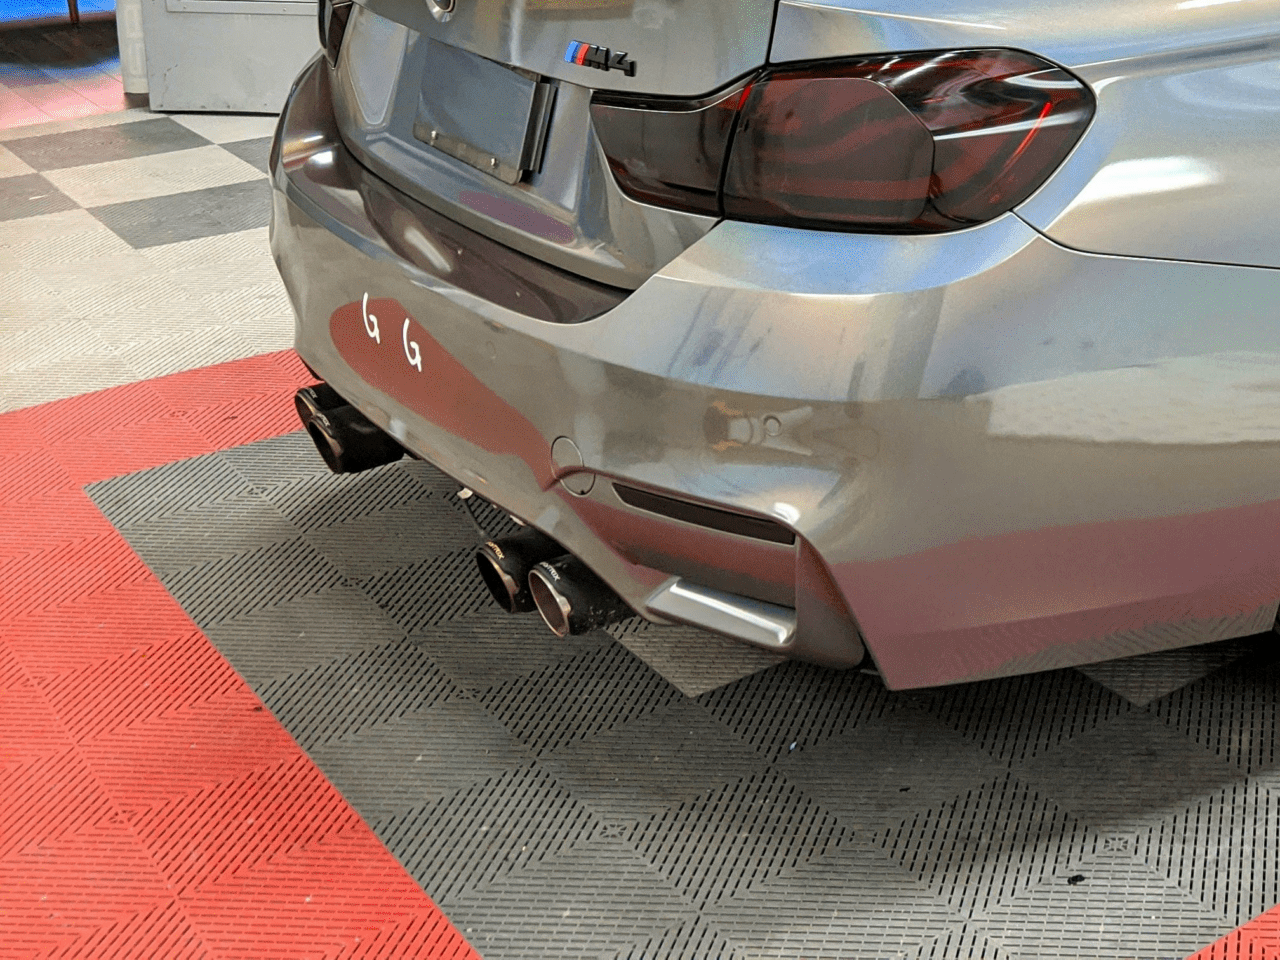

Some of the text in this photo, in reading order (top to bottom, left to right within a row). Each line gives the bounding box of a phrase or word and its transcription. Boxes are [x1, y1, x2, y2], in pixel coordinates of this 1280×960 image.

[584, 44, 637, 77] M4
[362, 291, 422, 373] G G
